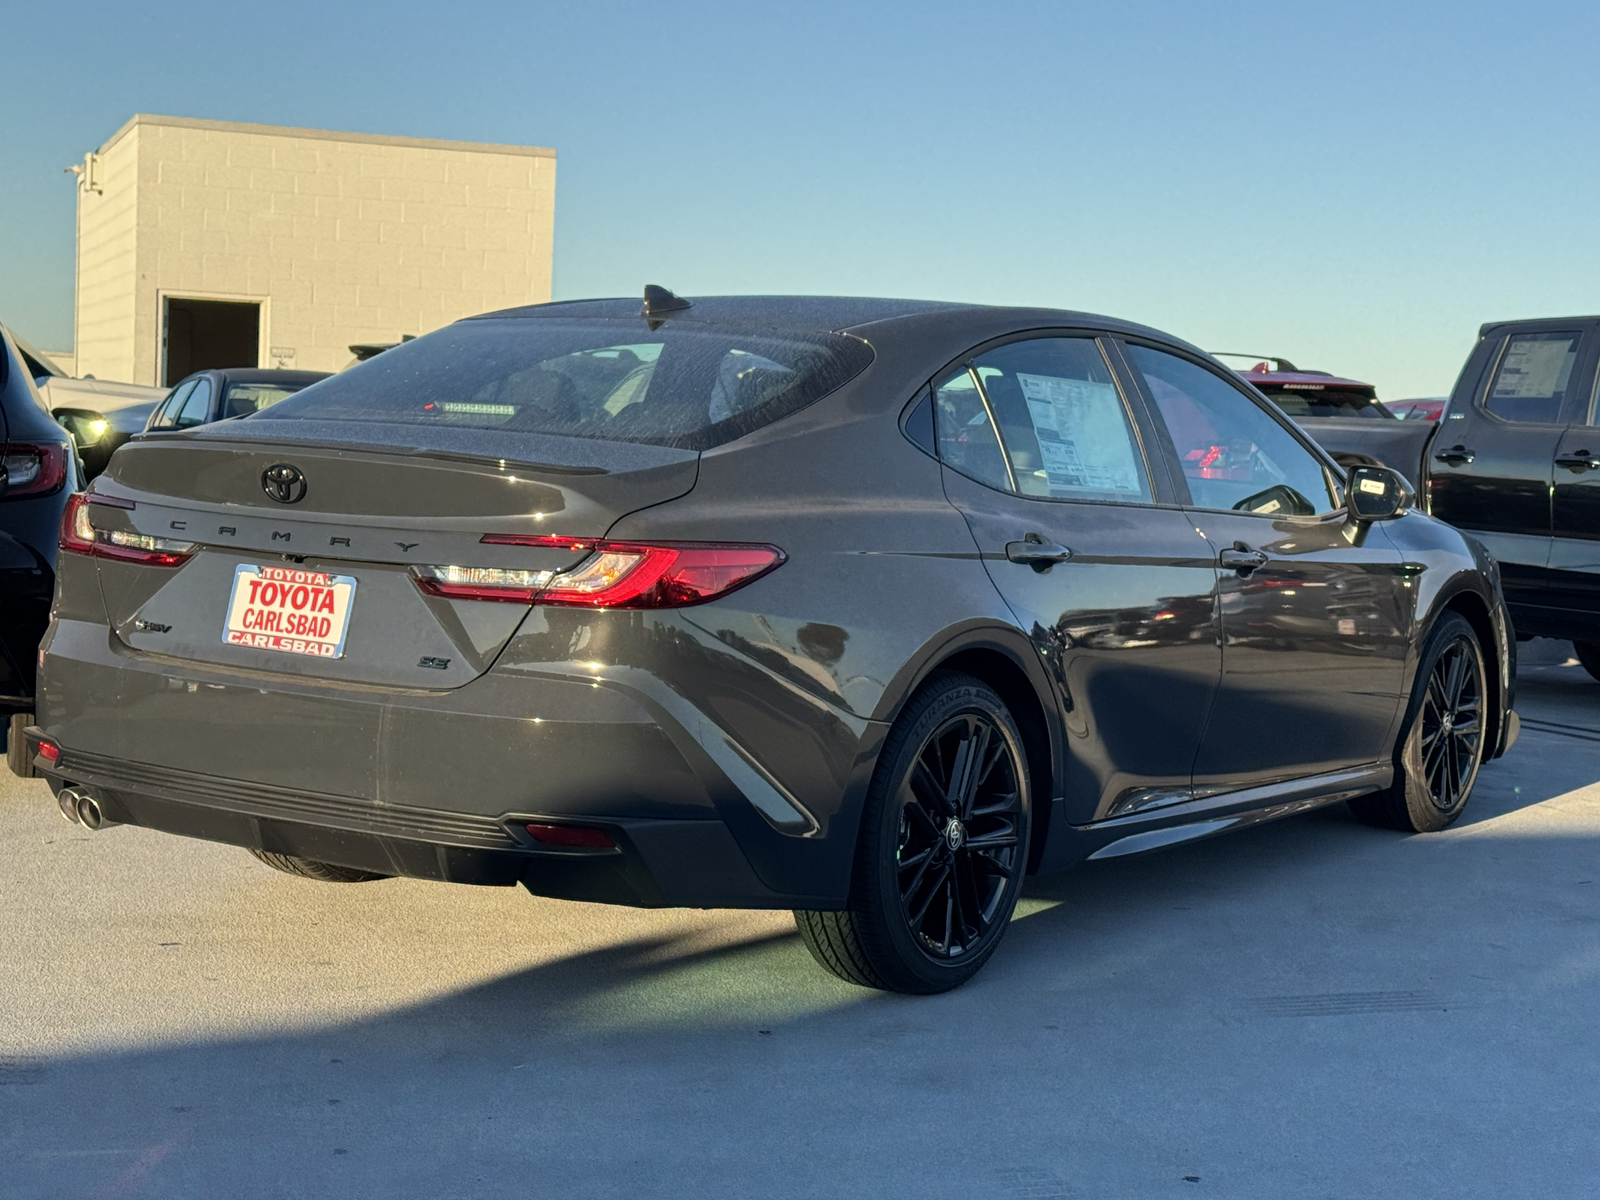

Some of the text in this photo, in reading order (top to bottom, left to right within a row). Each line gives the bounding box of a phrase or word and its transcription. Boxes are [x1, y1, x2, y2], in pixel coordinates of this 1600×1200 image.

[170, 520, 419, 552] CAMRY
[265, 568, 325, 586] TOYOTA
[249, 580, 335, 614] TOYOTA
[242, 608, 331, 638] CARLSBAD
[227, 631, 336, 657] CARLSBAD
[417, 656, 451, 670] SE
[912, 688, 971, 738] TURANZA
